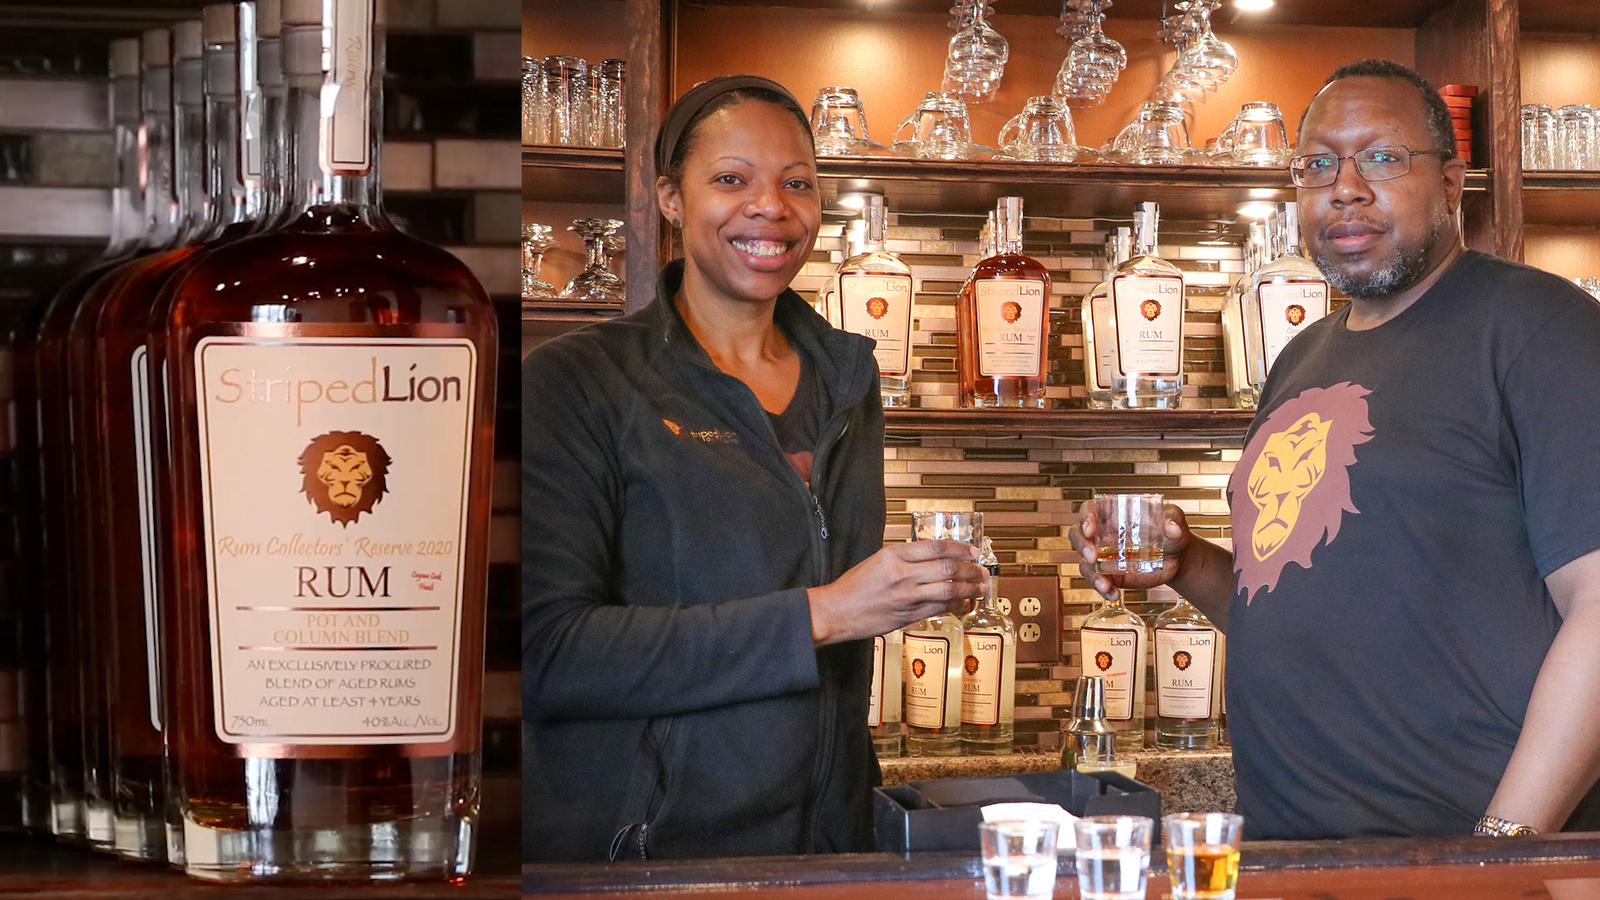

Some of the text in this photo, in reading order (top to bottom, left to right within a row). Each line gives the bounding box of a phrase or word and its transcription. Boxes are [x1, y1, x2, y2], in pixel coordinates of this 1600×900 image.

[980, 284, 1041, 298] StrpedLion
[1119, 282, 1178, 298] SpedLion
[1264, 287, 1323, 303] SpedLion
[865, 329, 889, 338] RUM
[1000, 333, 1023, 342] RUM
[1140, 330, 1163, 339] RUM
[215, 356, 461, 427] StripedLion
[218, 533, 452, 557] Rum Collectors' Reserve 2020
[294, 566, 392, 598] RUM
[306, 613, 380, 628] POT AND
[273, 629, 410, 644] COLUMN BLEND
[246, 659, 432, 671] AN EXCLUSIVELY PROCURED
[265, 677, 416, 690] BLEND OF AGED RUMS
[963, 683, 980, 693] RUM
[1171, 679, 1193, 687] RUM
[911, 686, 927, 696] RUM
[259, 695, 421, 708] AGED AT LEAST 4 YEARS
